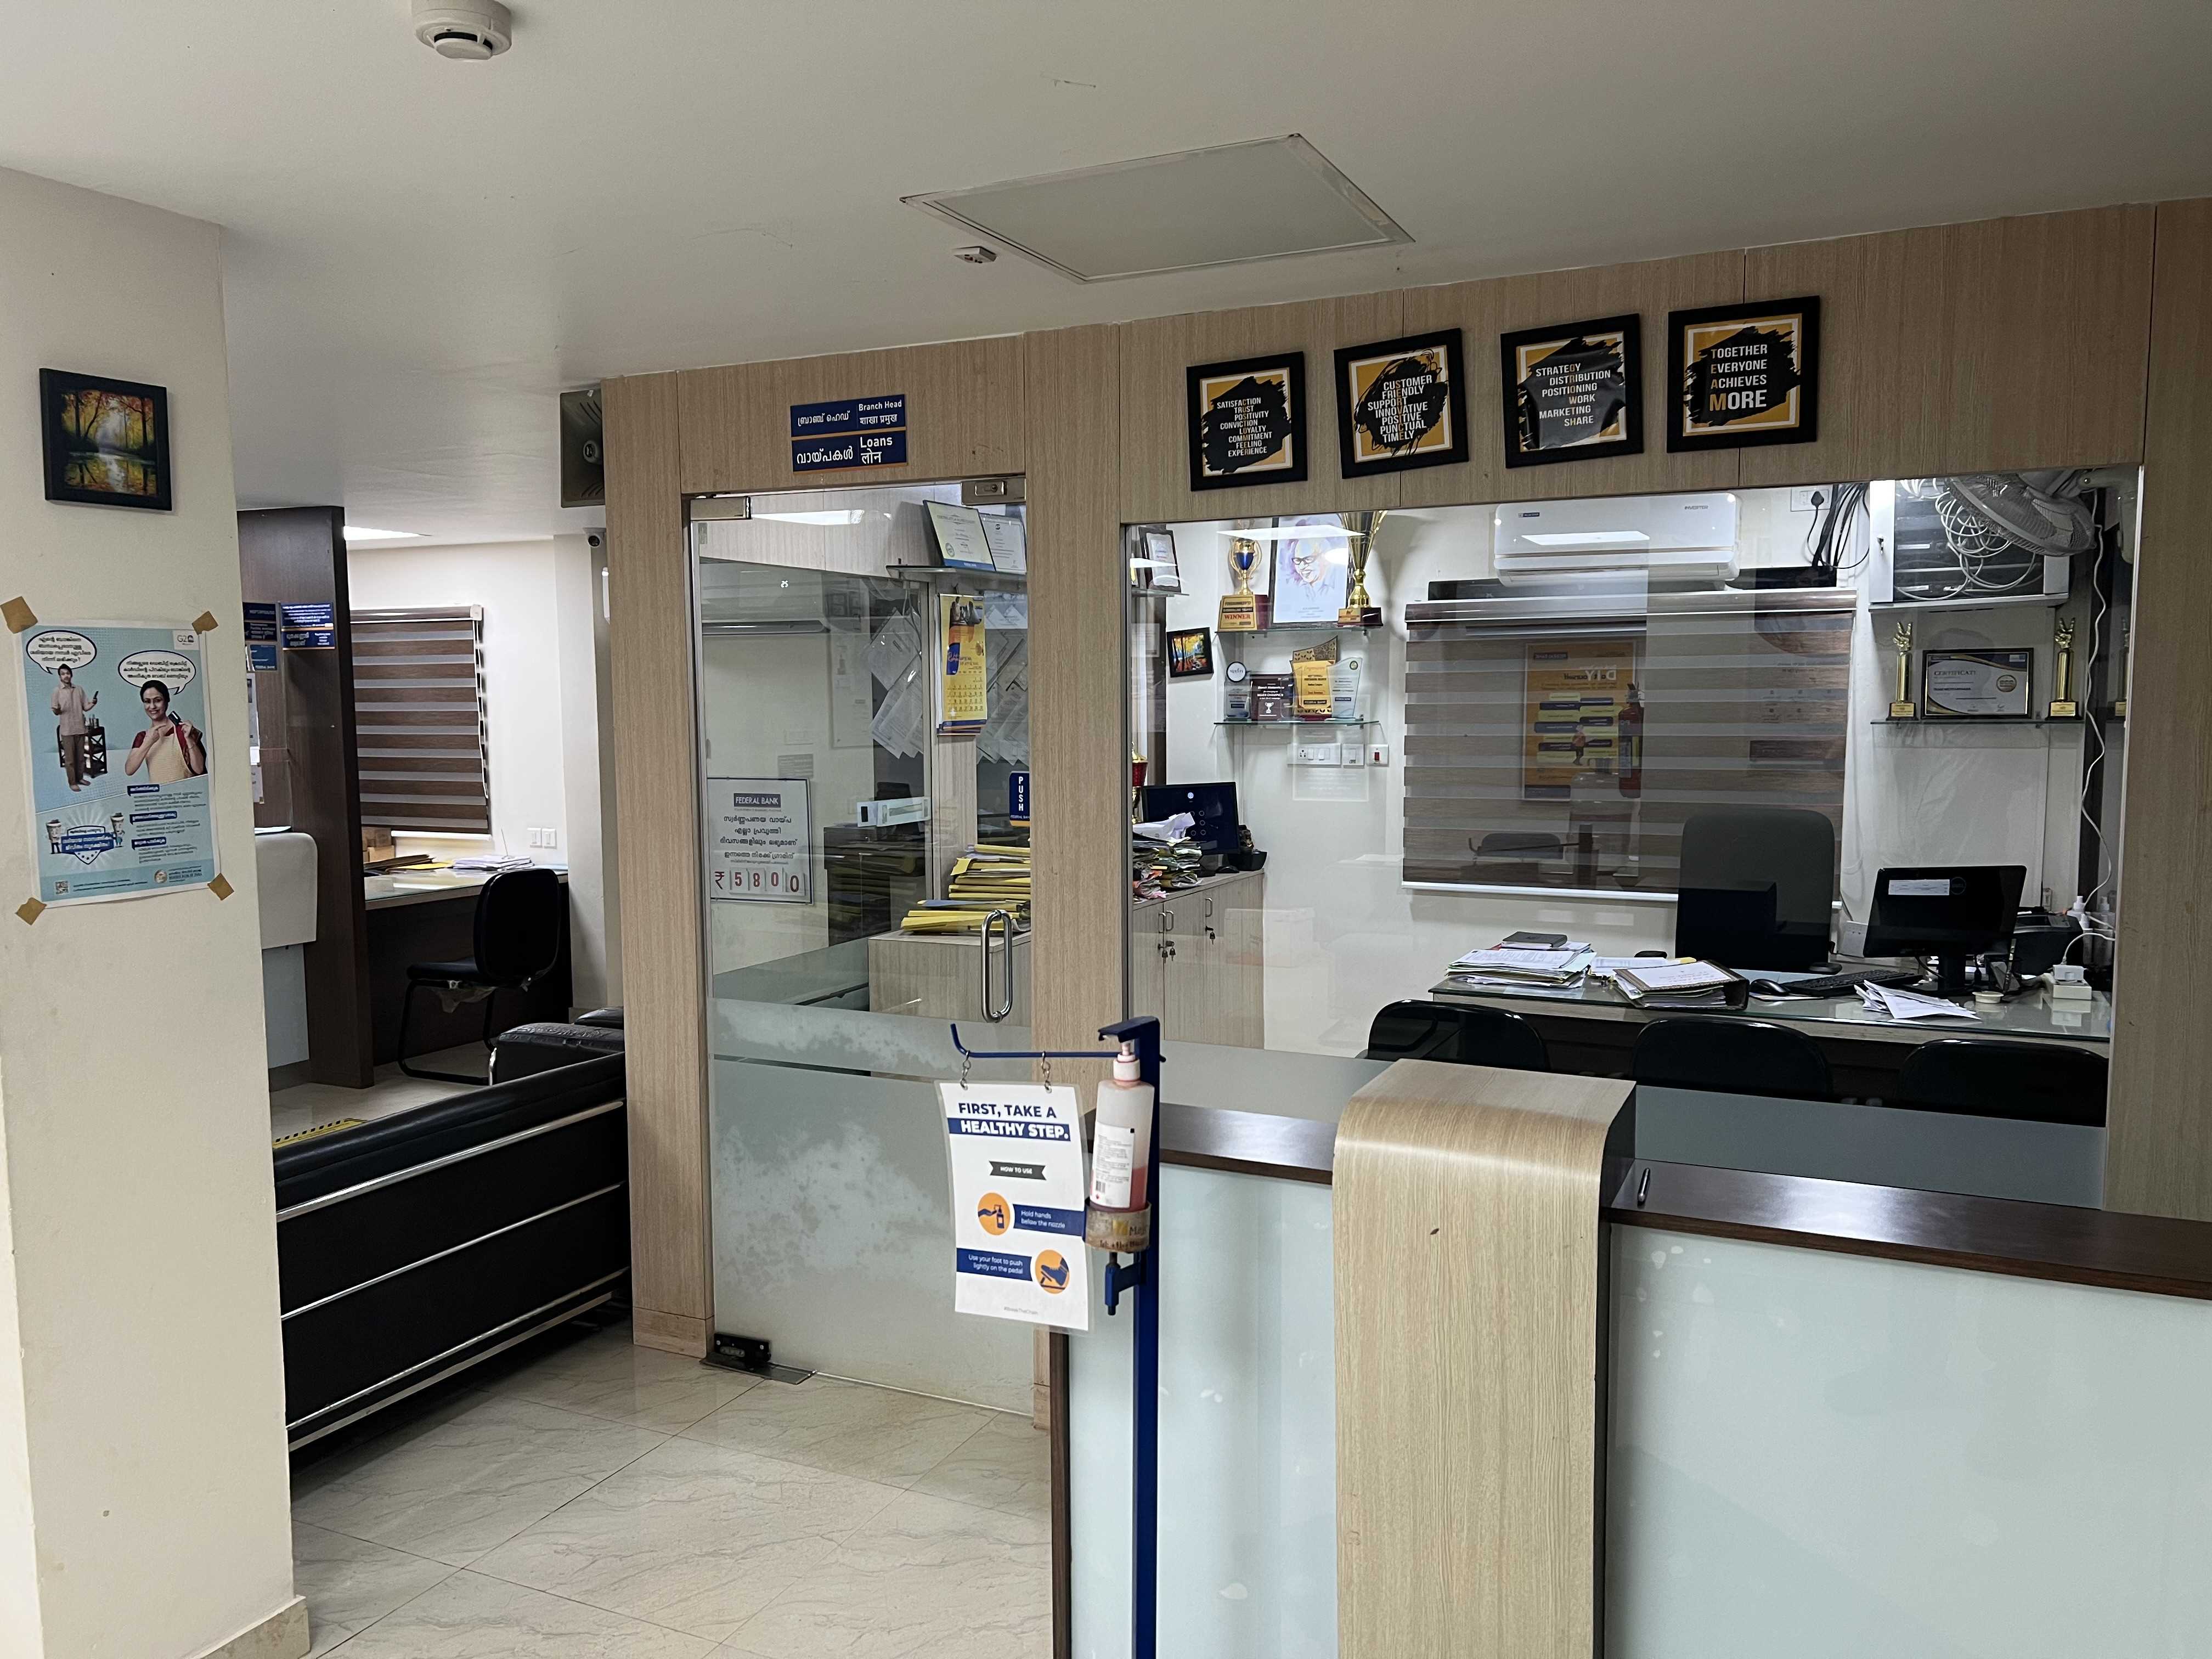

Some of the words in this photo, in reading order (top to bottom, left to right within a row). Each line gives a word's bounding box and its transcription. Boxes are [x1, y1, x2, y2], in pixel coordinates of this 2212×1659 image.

[1711, 344, 1768, 359] TOGETHER
[1536, 363, 1581, 377] STRATEGY
[1711, 359, 1768, 374] EVERYONE
[1384, 375, 1432, 391] CUSTOMER
[1550, 370, 1611, 386] DISTRIBUTION
[1711, 375, 1767, 390] ACHIEVES
[1382, 385, 1424, 400] FRIENDLY
[1542, 382, 1598, 397] POSITIONING
[859, 402, 883, 411] Branch
[884, 400, 902, 409] Head
[1217, 397, 1261, 409] SATISFACTION
[1368, 396, 1407, 411] SUPPORT
[1568, 393, 1595, 405] WORK
[1709, 390, 1768, 411] MORE
[1234, 405, 1254, 414] TRUST
[1234, 410, 1269, 421] POSITIVITY
[1375, 402, 1428, 418] INNOVATIVE
[1539, 405, 1591, 419] MARKETING
[798, 413, 825, 426] ബ്രാഞ്ച്
[827, 410, 850, 422] ഹെഡ്
[860, 416, 878, 425] शाखा
[880, 414, 898, 425] प्रमुख
[1220, 419, 1258, 430] CONVICTION
[1382, 411, 1422, 426] POSITIVE
[1564, 415, 1594, 427] SHARE
[1239, 425, 1267, 435] LOYALTY
[1380, 420, 1426, 435] PUNCTUAL
[860, 437, 893, 448] Loans
[1228, 431, 1272, 443] COMMITMENT
[1382, 430, 1415, 443] TIMELY
[797, 446, 853, 464] വായ്പകൾ
[861, 449, 882, 464] लोन
[1228, 446, 1267, 457] EXPERIENCE
[958, 1103, 1001, 1118] FIRST,
[1004, 1104, 1042, 1118] TAKE
[1046, 1107, 1057, 1118] A
[961, 1120, 1025, 1137] HEALTHY
[1028, 1124, 1069, 1139] STEP.
[973, 1262, 989, 1272] lightly
